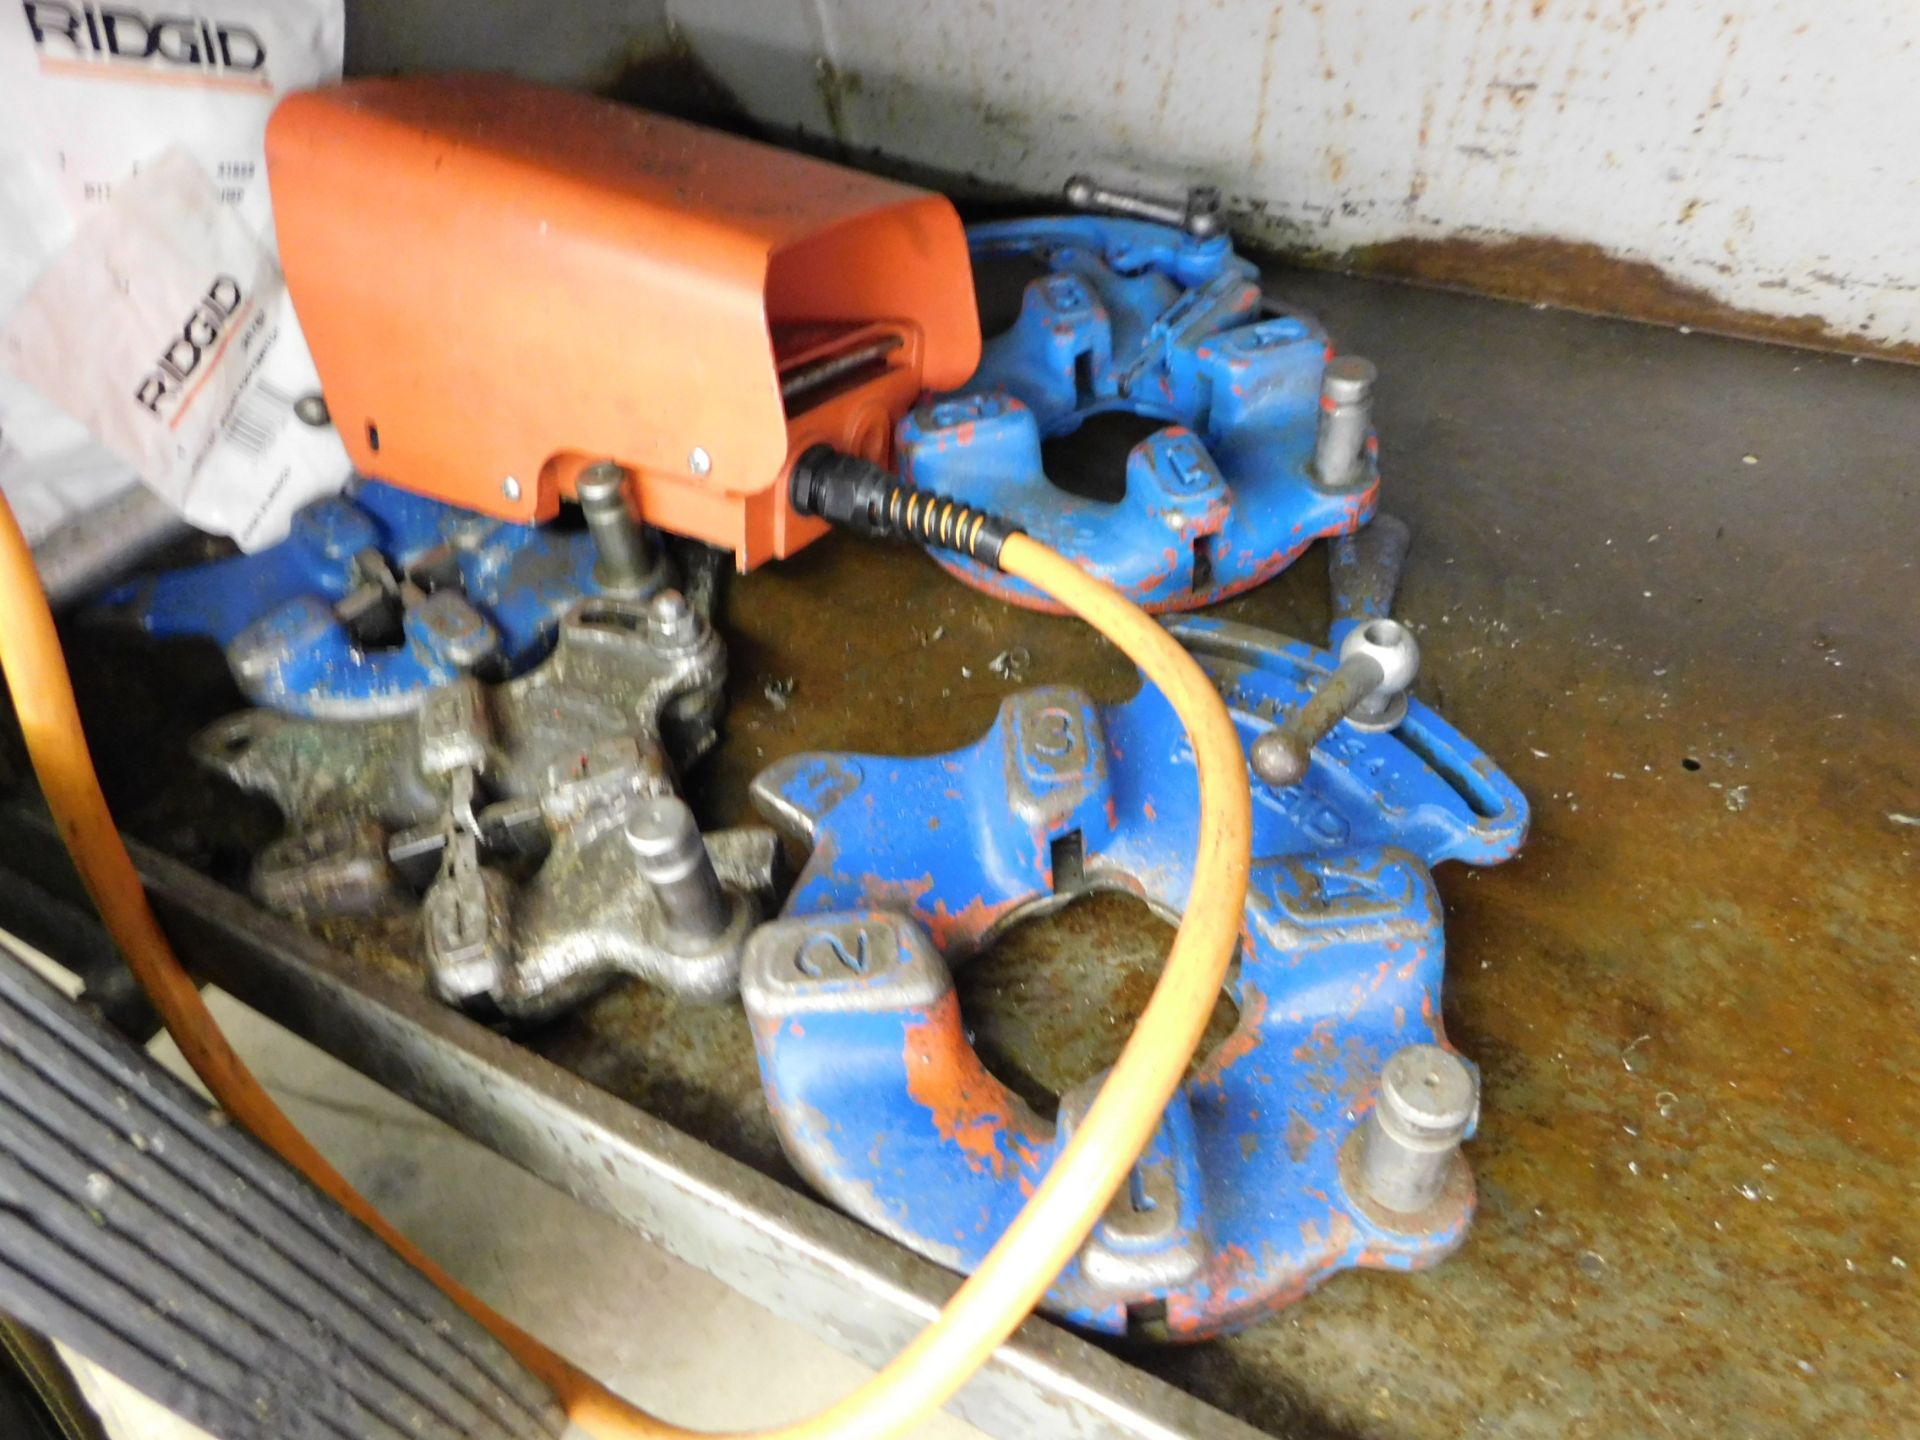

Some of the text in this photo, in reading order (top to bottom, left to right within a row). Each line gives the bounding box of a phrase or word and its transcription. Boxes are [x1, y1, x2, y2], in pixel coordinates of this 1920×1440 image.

[23, 2, 267, 70] RIDGID
[135, 274, 242, 414] RIDGID
[794, 927, 869, 977] 2
